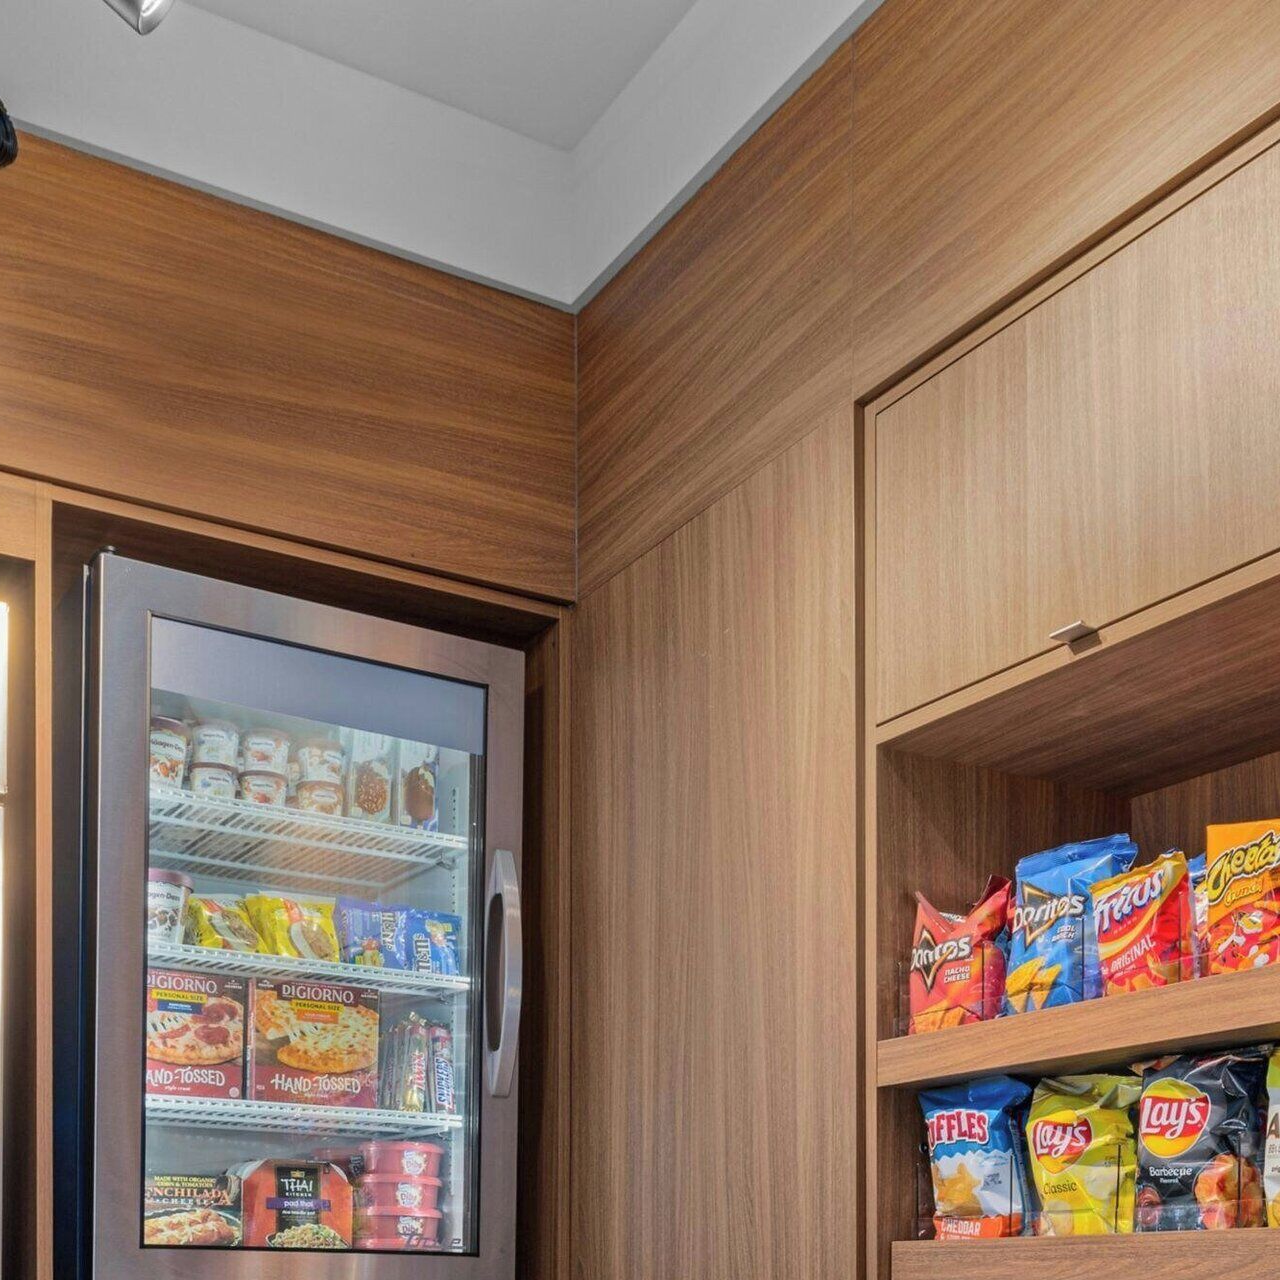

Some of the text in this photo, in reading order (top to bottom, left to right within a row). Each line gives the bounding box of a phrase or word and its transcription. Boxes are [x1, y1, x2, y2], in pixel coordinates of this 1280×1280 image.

[1093, 868, 1166, 935] Fritos
[1141, 1097, 1208, 1139] Lay's
[1035, 1121, 1088, 1159] Lay's
[1149, 1166, 1193, 1178] Barbecue
[280, 1178, 314, 1193] THAI
[1042, 1180, 1077, 1195] Classic
